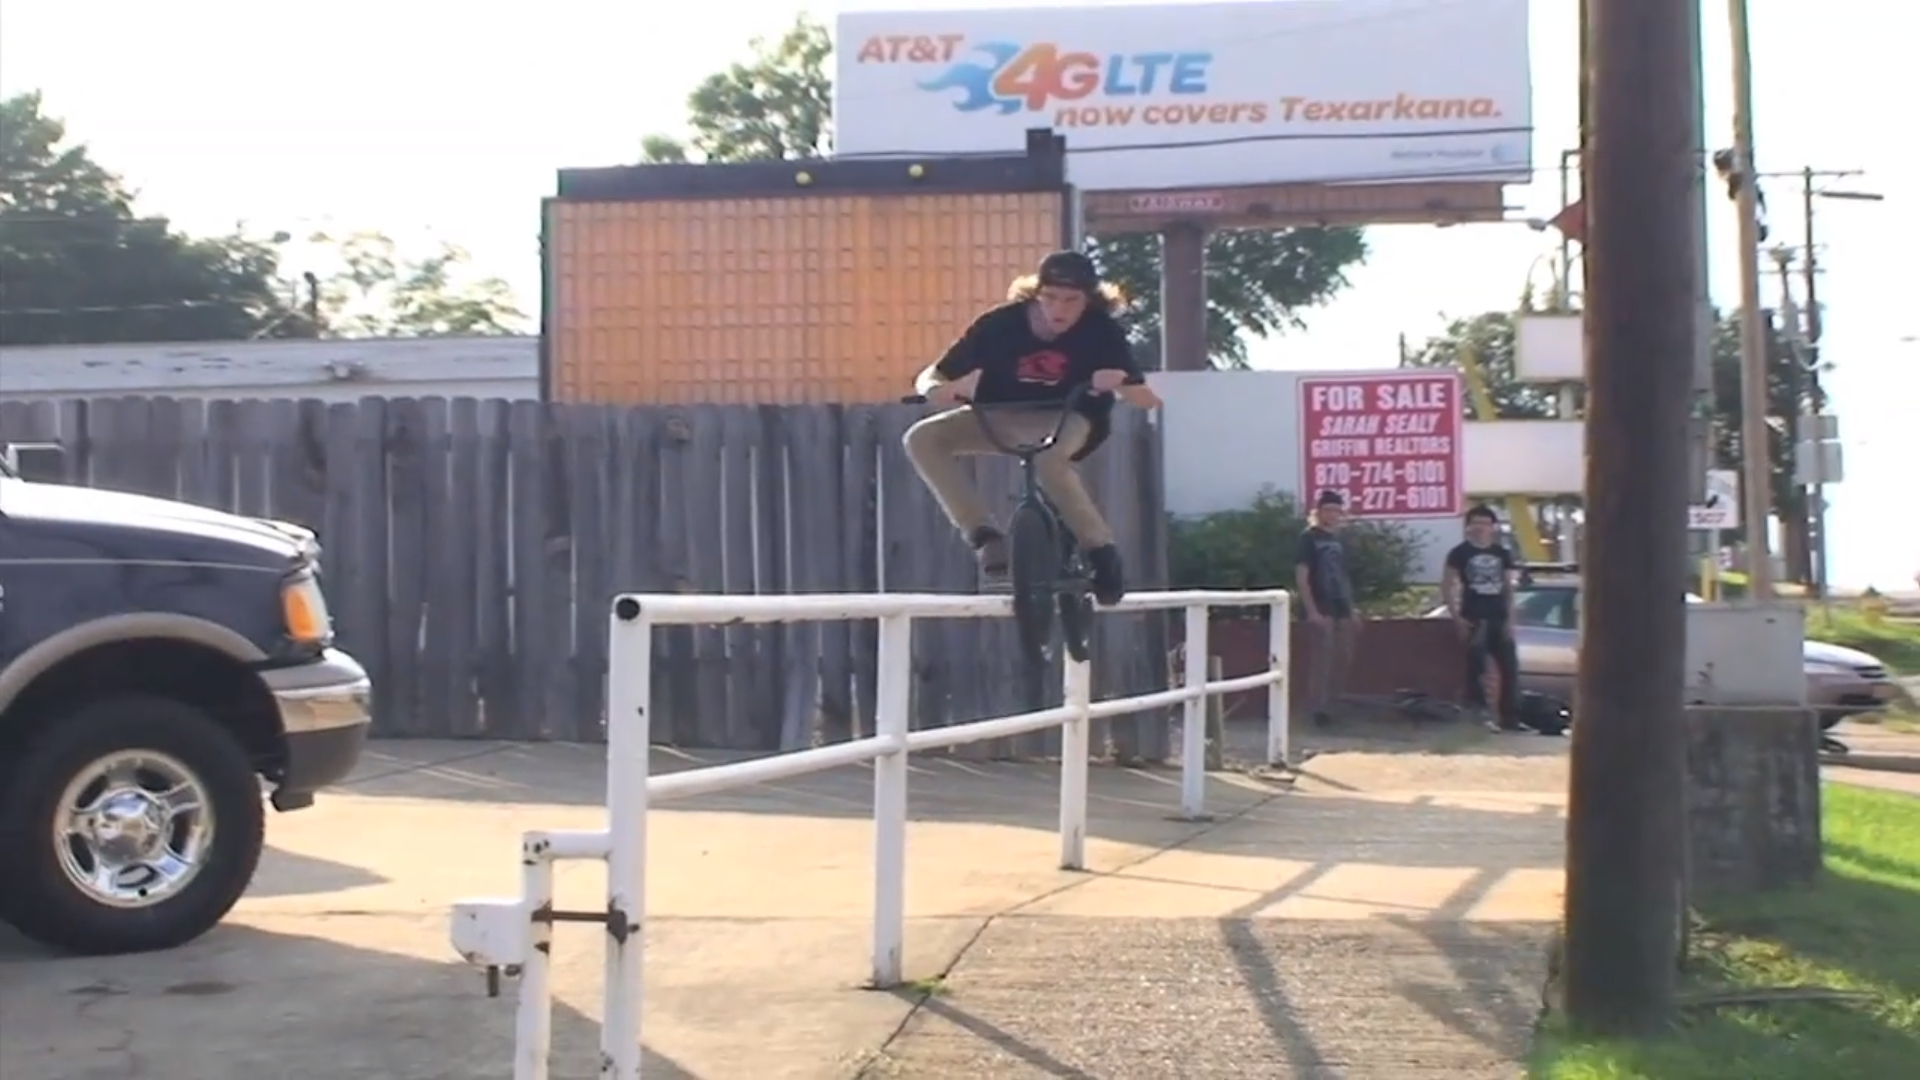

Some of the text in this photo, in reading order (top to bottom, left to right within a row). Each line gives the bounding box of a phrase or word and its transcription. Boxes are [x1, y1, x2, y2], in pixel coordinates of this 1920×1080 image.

[857, 35, 964, 62] AT&T
[993, 42, 1212, 112] 4G LTE
[1054, 94, 1502, 127] now covers Texarkana.
[1312, 383, 1446, 412] FOR SALE
[1319, 413, 1441, 436] SARAH SEALY
[1311, 437, 1451, 457] GRIFFIN REALTORS
[1315, 460, 1446, 486] 870-774-6101
